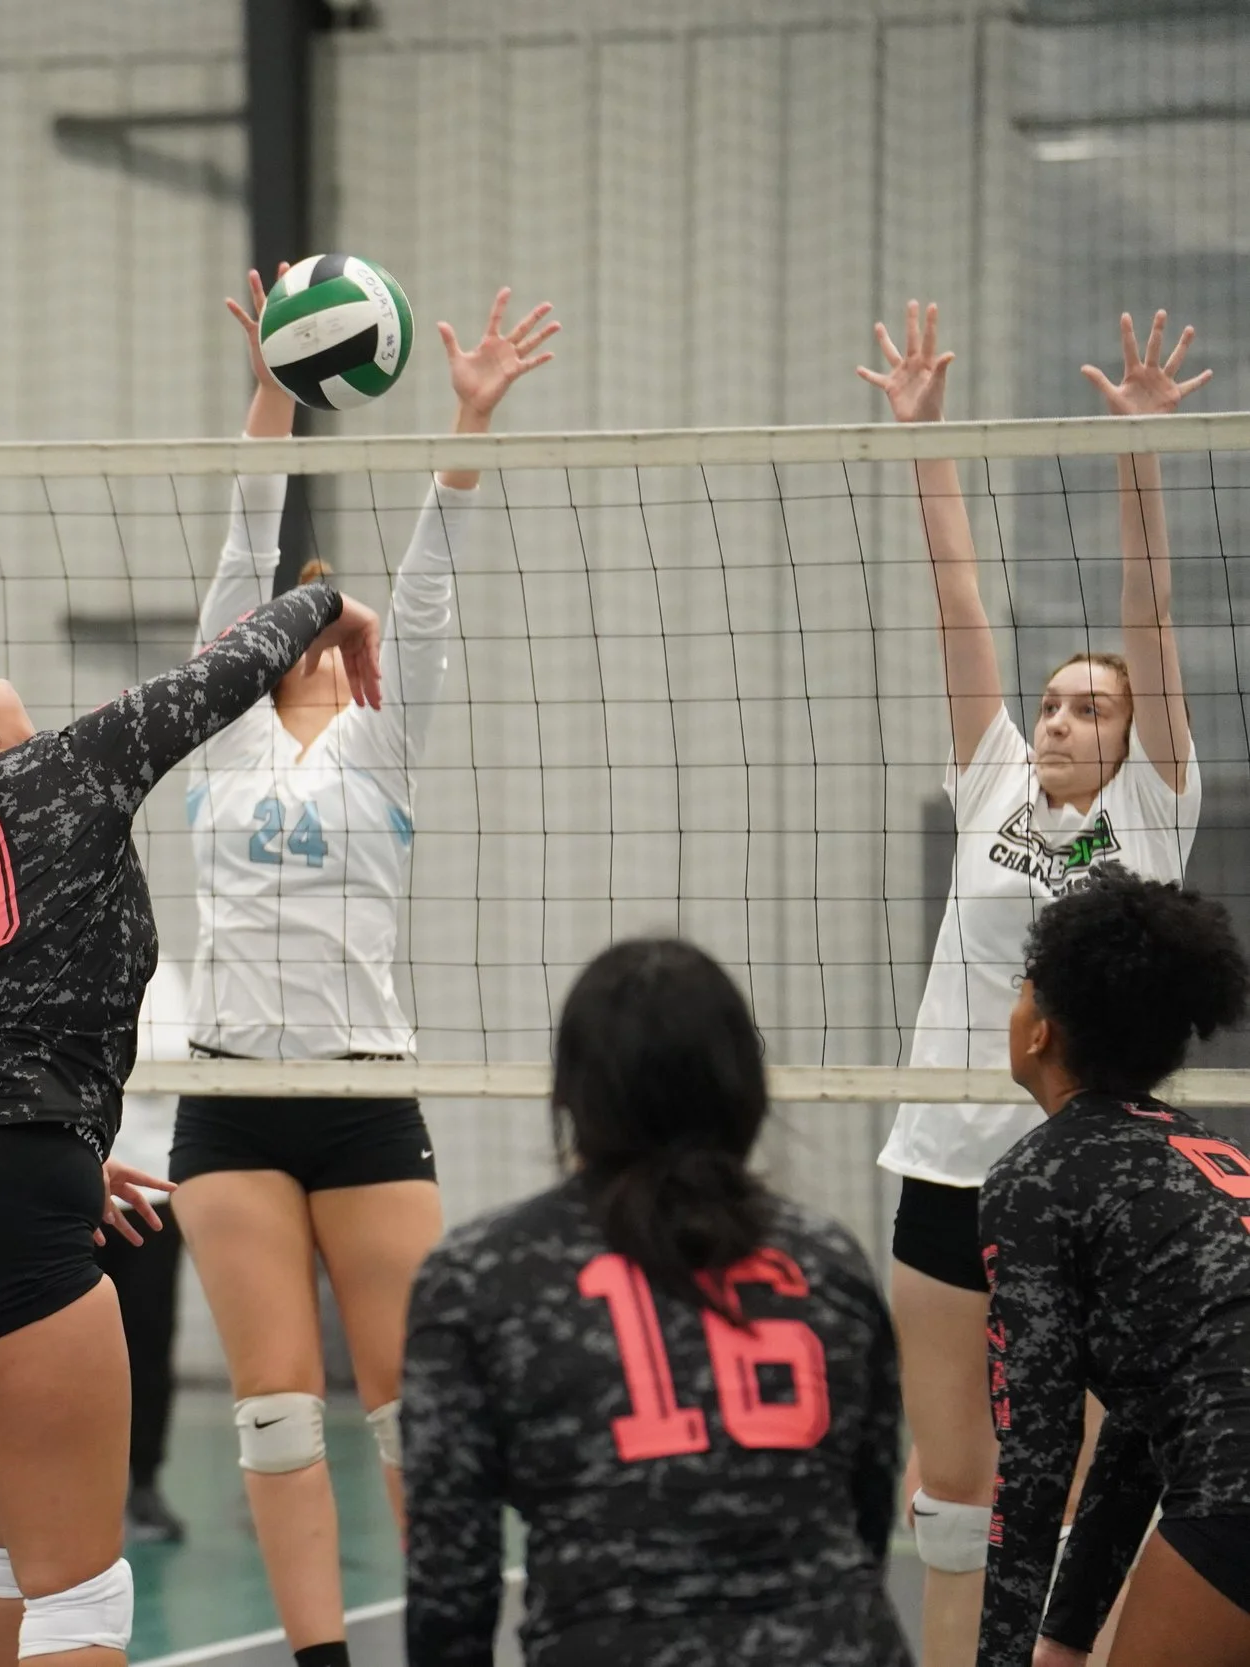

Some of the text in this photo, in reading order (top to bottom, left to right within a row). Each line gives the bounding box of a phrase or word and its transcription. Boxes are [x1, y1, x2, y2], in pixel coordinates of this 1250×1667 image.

[357, 268, 394, 320] COURT
[248, 796, 329, 868] 24
[576, 1247, 831, 1464] 16
